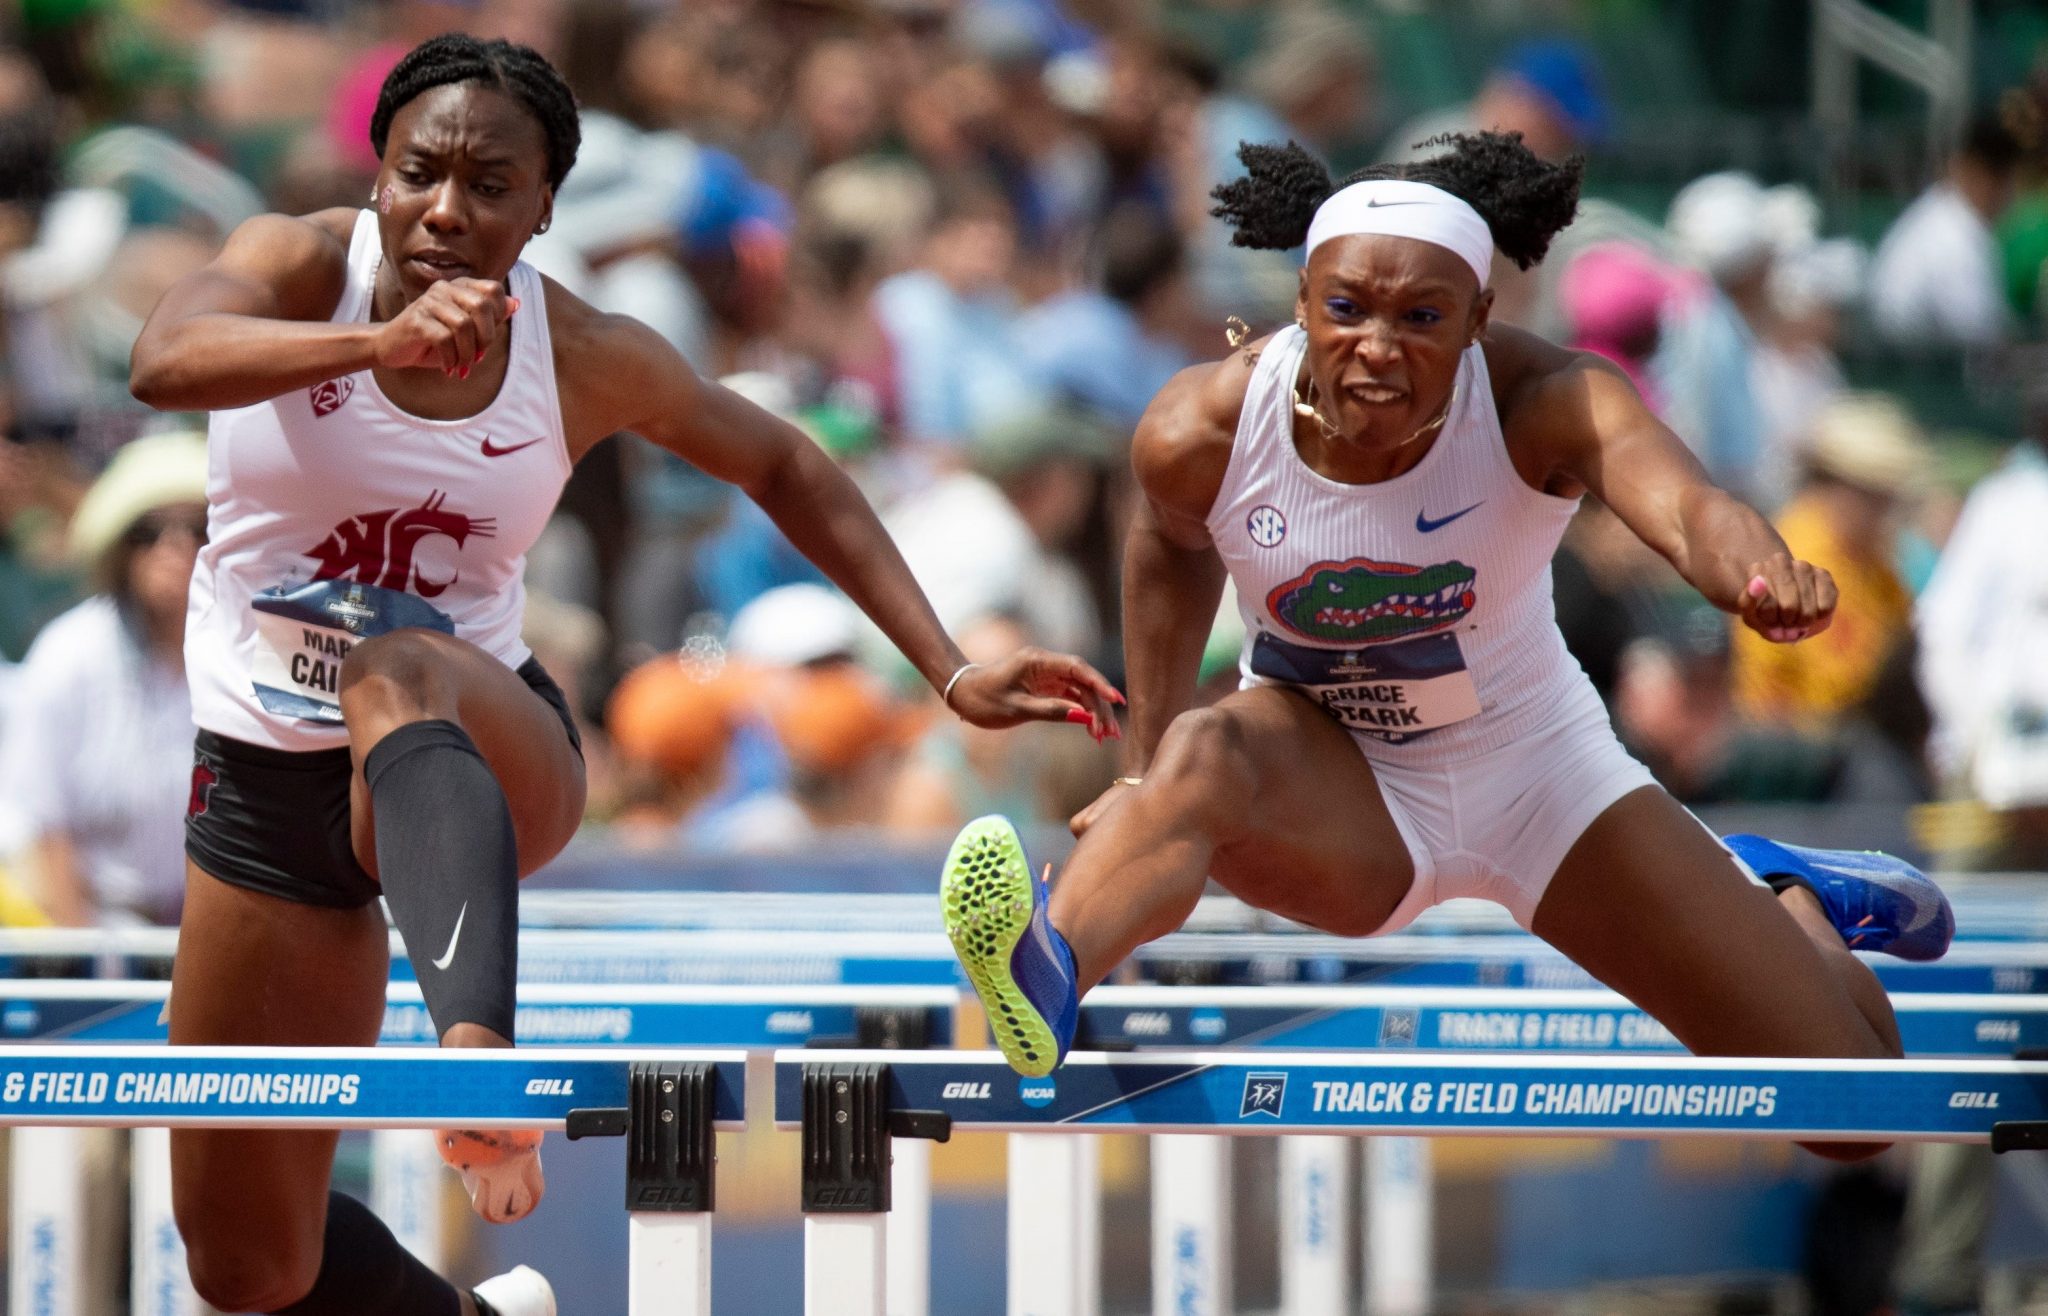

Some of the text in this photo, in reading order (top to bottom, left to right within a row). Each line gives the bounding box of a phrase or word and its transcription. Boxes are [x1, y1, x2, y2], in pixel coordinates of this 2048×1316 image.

[291, 652, 337, 693] CAI
[1321, 685, 1406, 703] GRACE
[1322, 701, 1422, 727] STARK
[3, 1072, 24, 1102] &
[29, 1072, 108, 1103] FIELD
[115, 1073, 360, 1105] CHAMPIONSHIPS
[525, 1079, 573, 1095] GILL
[942, 1082, 991, 1098] GILL
[1022, 1088, 1055, 1098] NCAA
[1312, 1081, 1777, 1116] TRACK & FIELD CHAMPIONSHIPS
[1949, 1092, 1999, 1108] GILL
